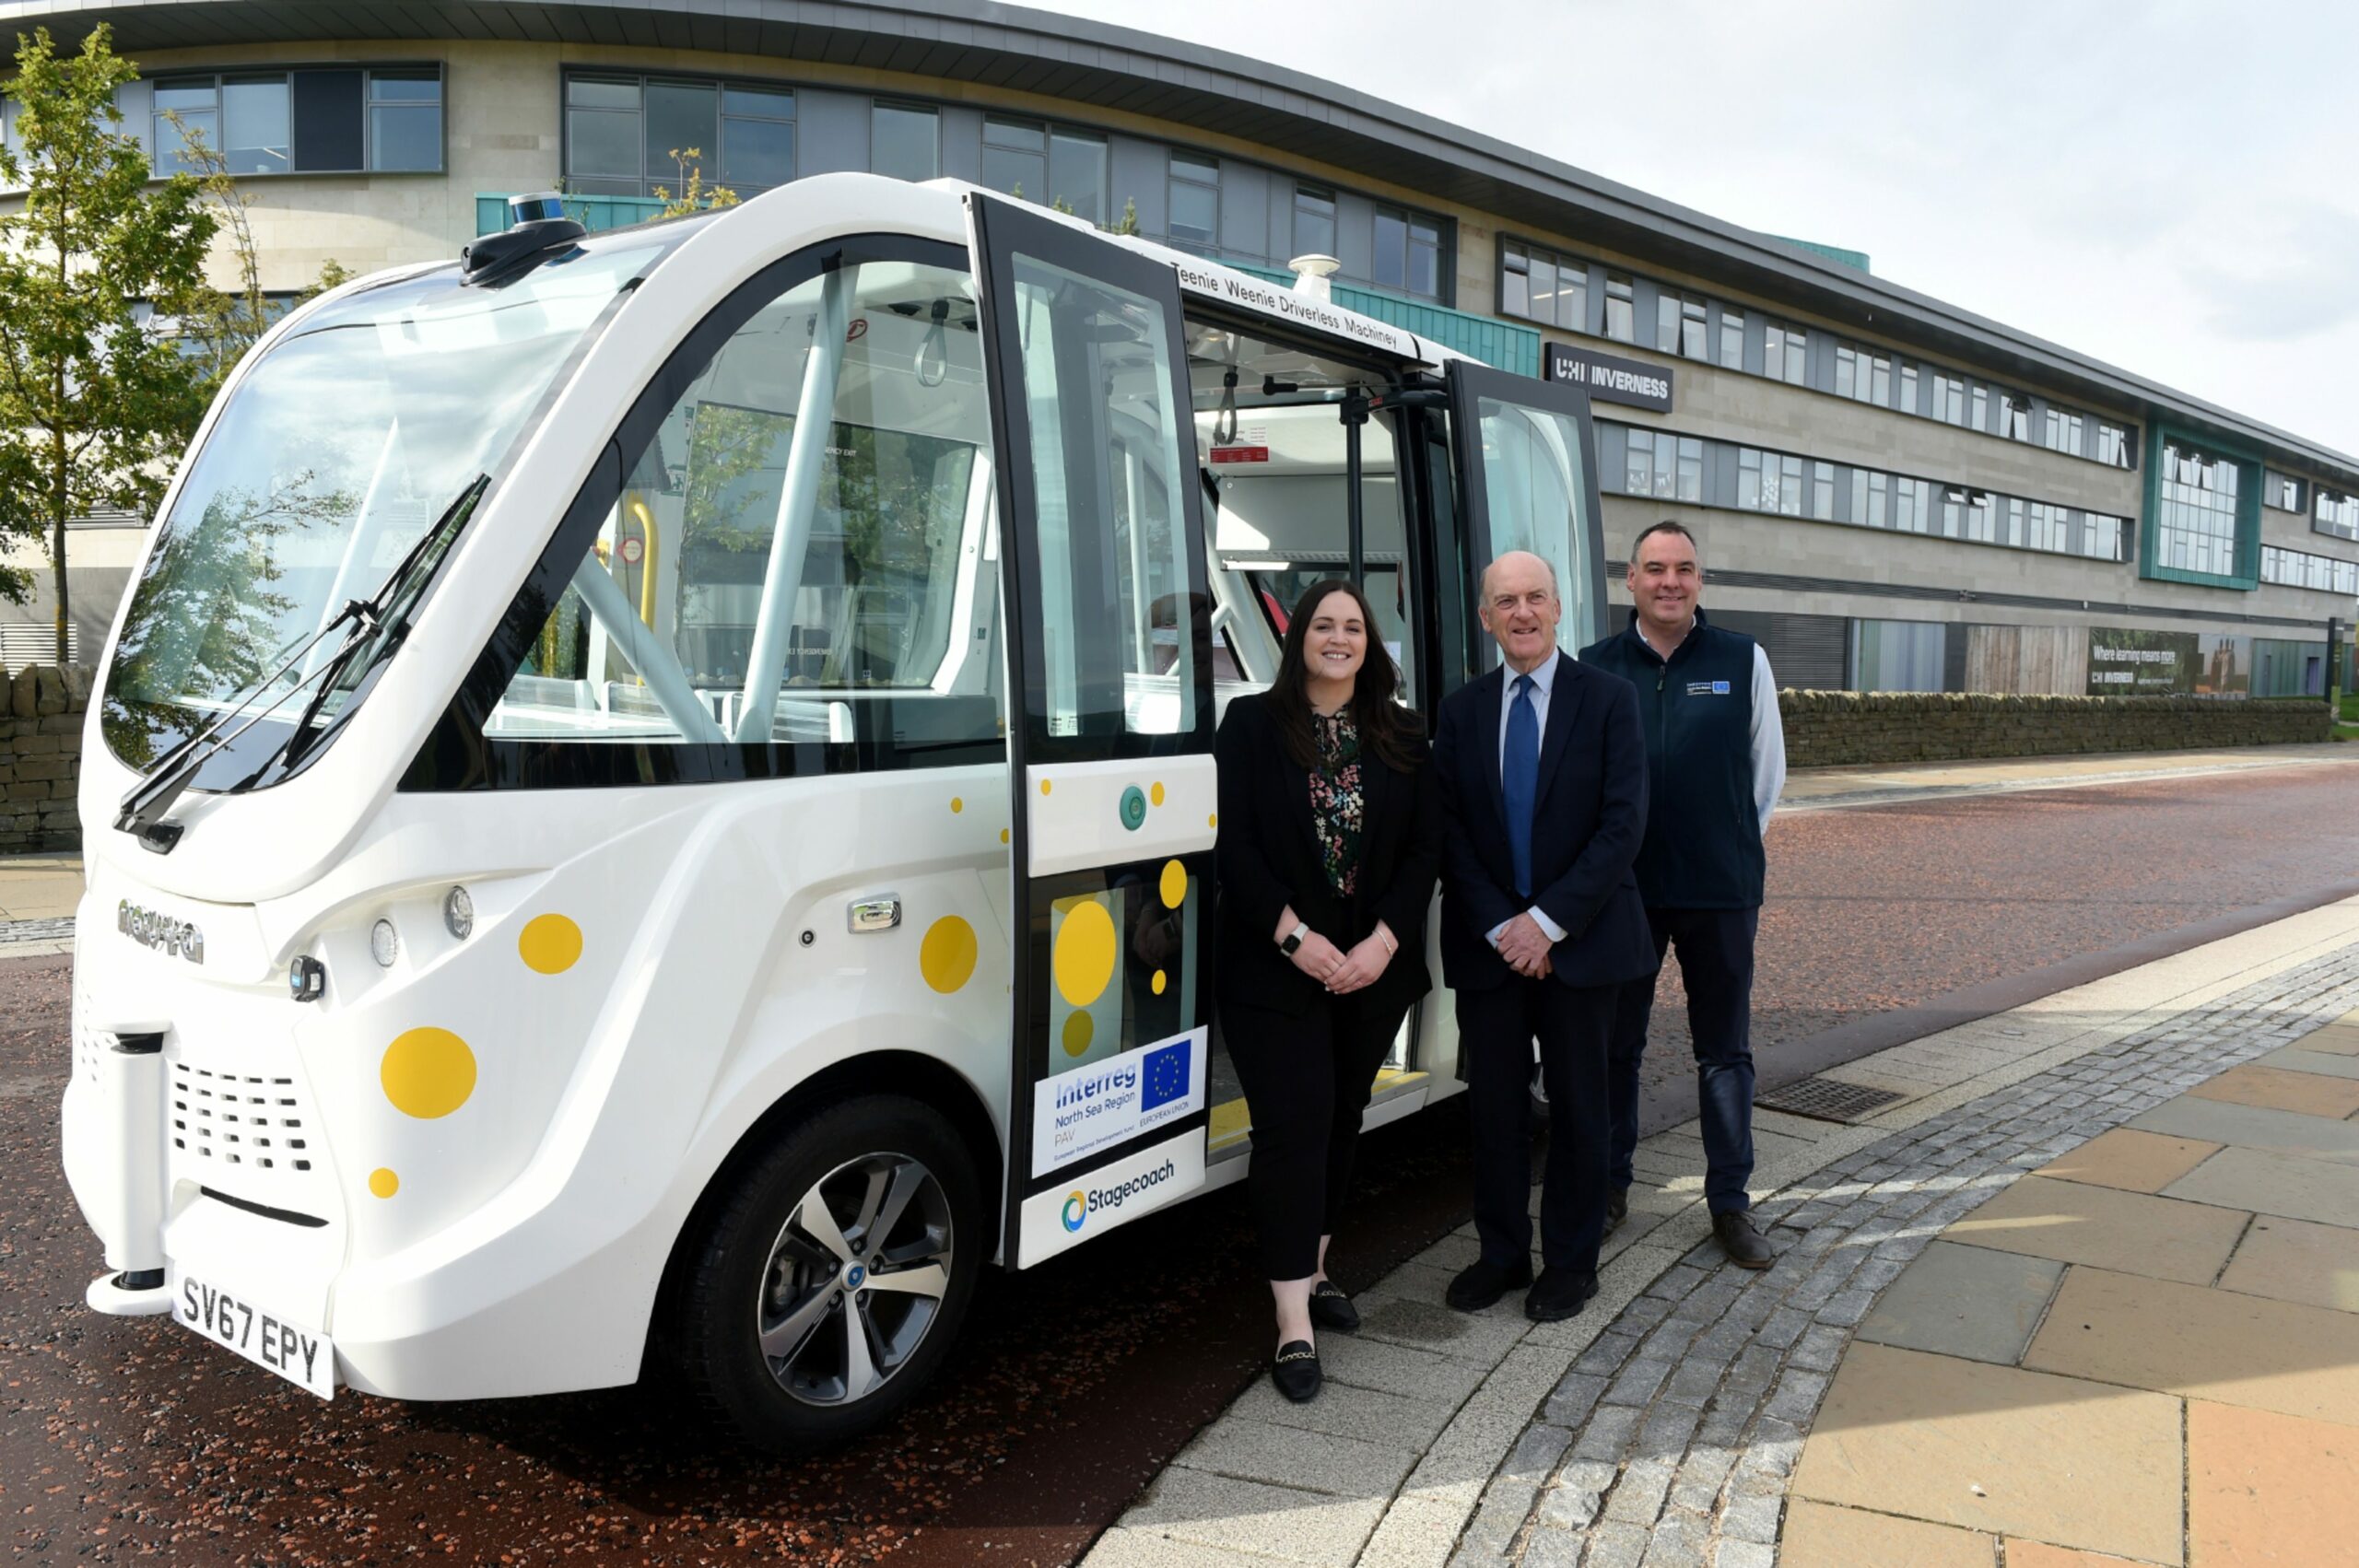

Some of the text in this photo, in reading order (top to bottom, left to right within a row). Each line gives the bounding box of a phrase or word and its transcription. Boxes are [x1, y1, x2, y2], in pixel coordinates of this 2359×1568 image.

[1170, 262, 1397, 349] Teenie Weenie Driverless Machiney
[1555, 357, 1668, 399] UHI INVERNESS
[2094, 645, 2176, 665] Where learning means more
[1056, 1062, 1136, 1109] Interreg
[1055, 1091, 1136, 1129] North Sea Region
[1140, 1101, 1190, 1128] EUROPEAN UNION
[1054, 1129, 1076, 1147] PAV
[1088, 1158, 1175, 1213] Stagecoach
[183, 1276, 318, 1384] SV67 EPY
